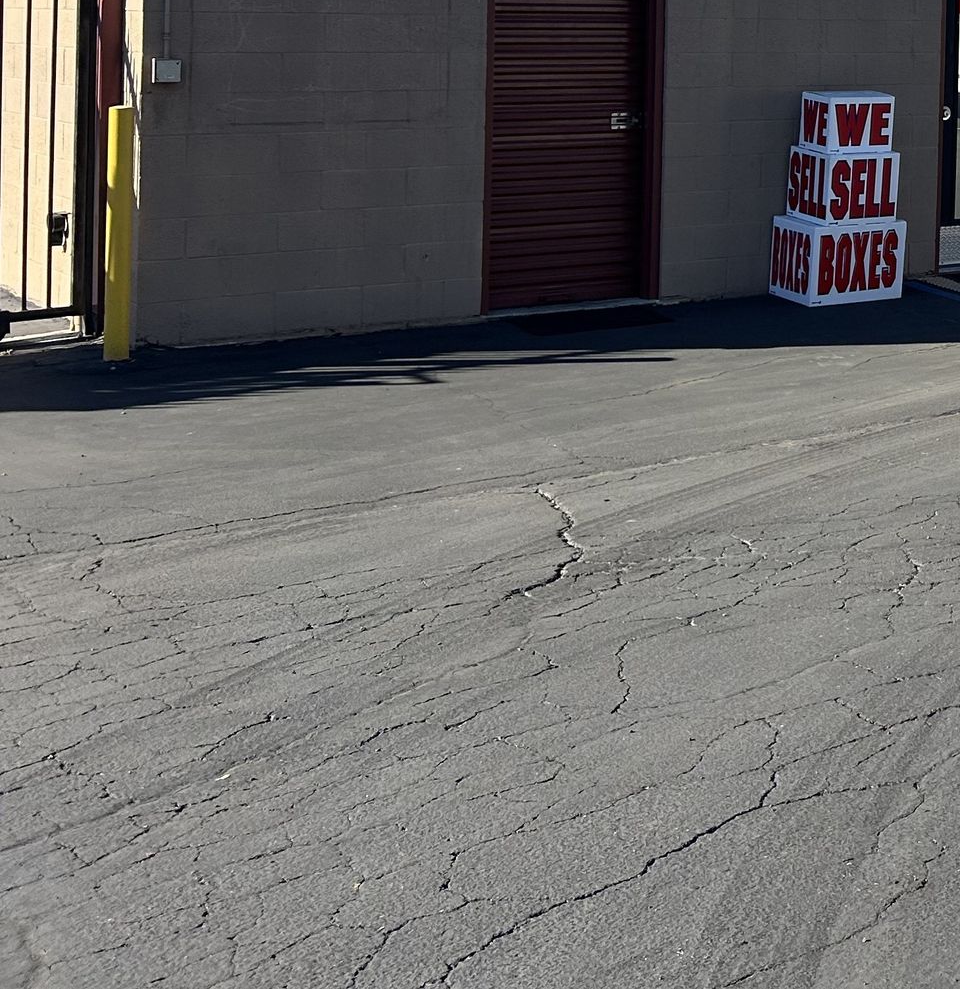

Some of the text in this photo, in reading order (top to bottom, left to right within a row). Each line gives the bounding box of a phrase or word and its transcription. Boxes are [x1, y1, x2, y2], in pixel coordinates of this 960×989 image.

[804, 99, 829, 146] WE
[835, 103, 891, 147] WE
[789, 151, 826, 220] SELL
[830, 158, 895, 220] SELL
[771, 226, 811, 295] BOXES
[818, 229, 898, 296] BOXES
